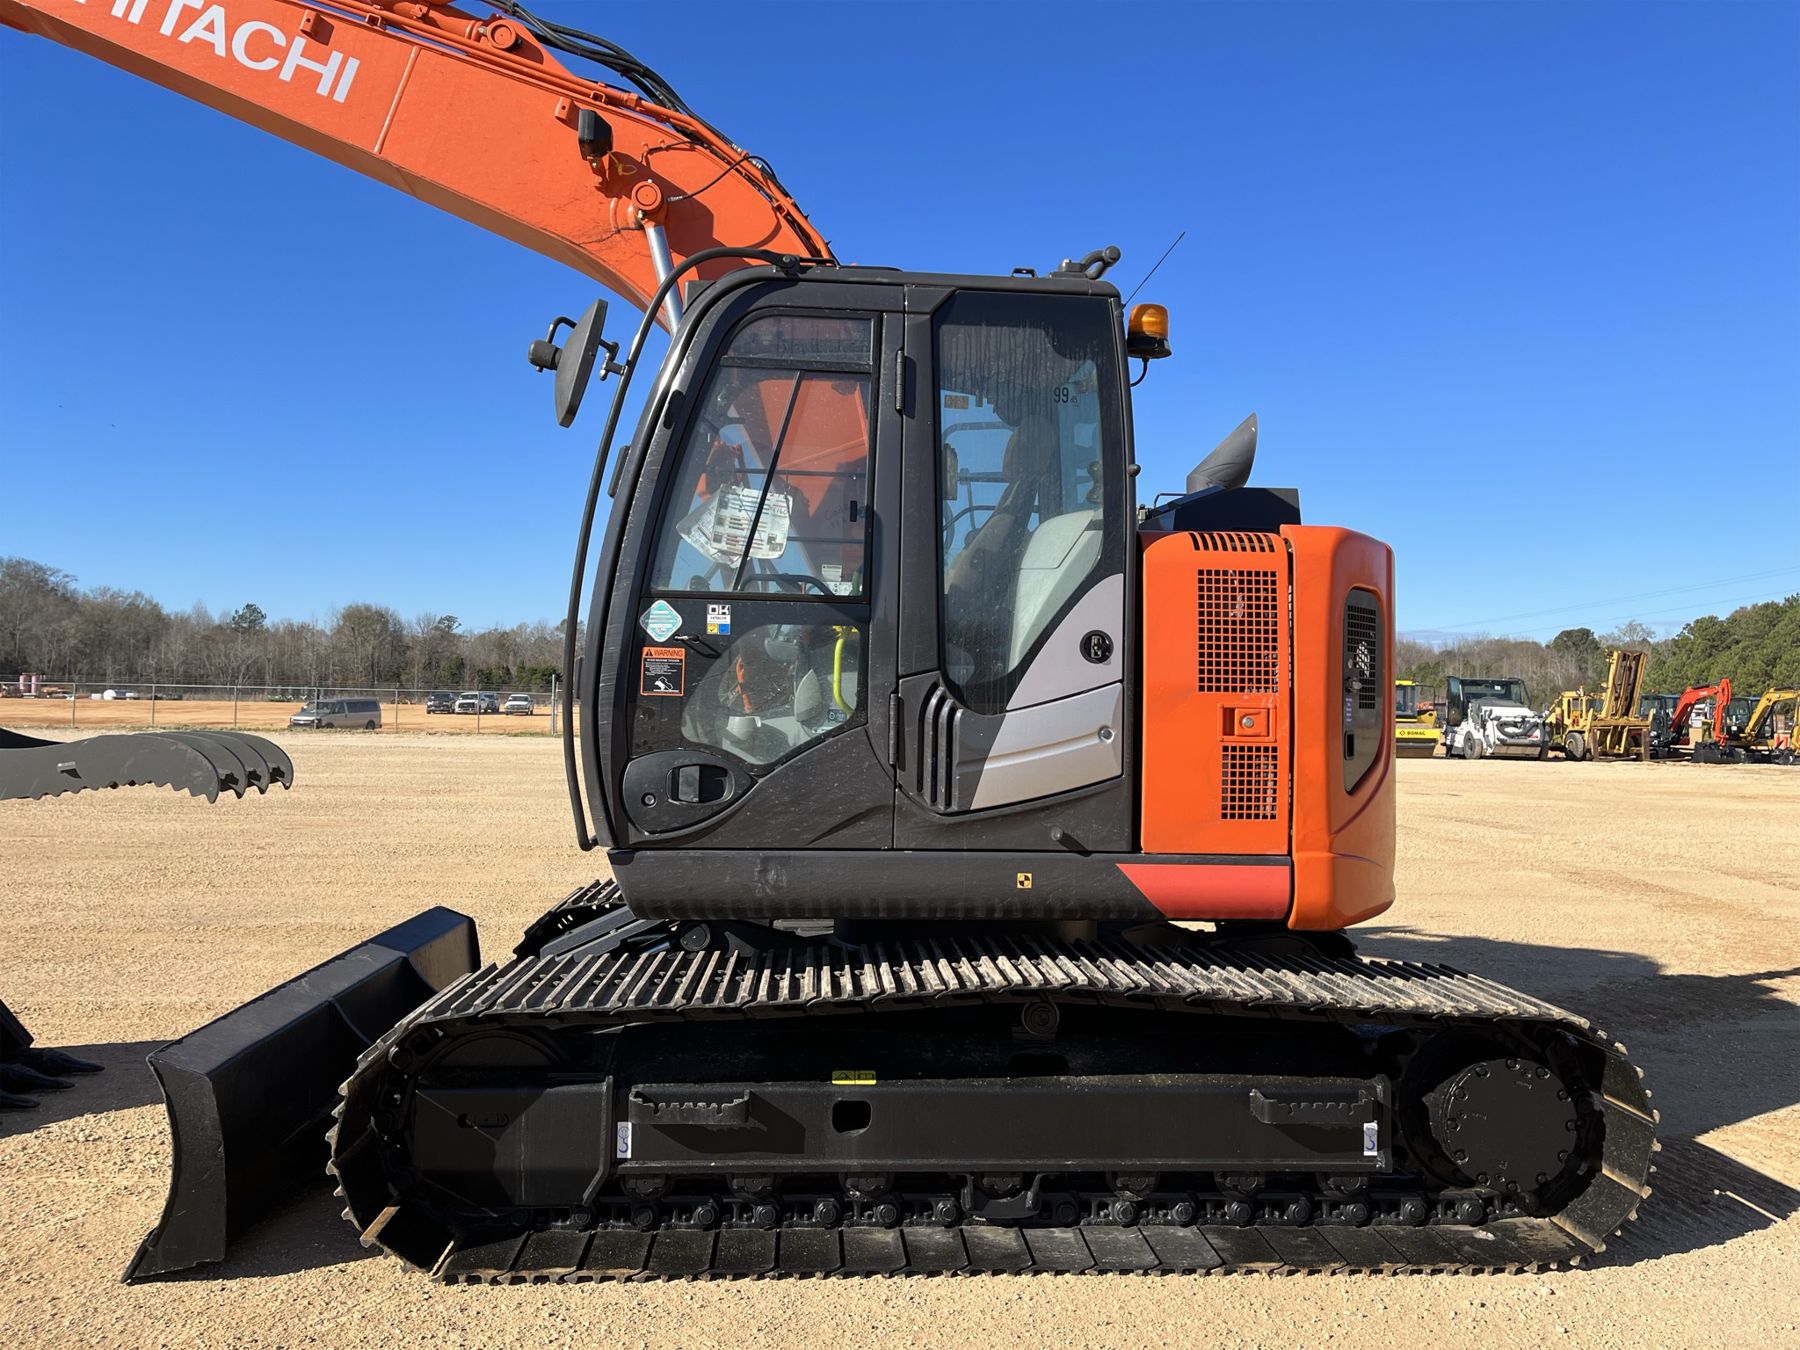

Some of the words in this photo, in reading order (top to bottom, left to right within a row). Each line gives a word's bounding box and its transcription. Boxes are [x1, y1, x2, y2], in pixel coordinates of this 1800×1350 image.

[75, 0, 361, 104] ITACHI
[1054, 387, 1069, 403] 99
[708, 604, 730, 615] OK
[654, 650, 684, 658] WARNING
